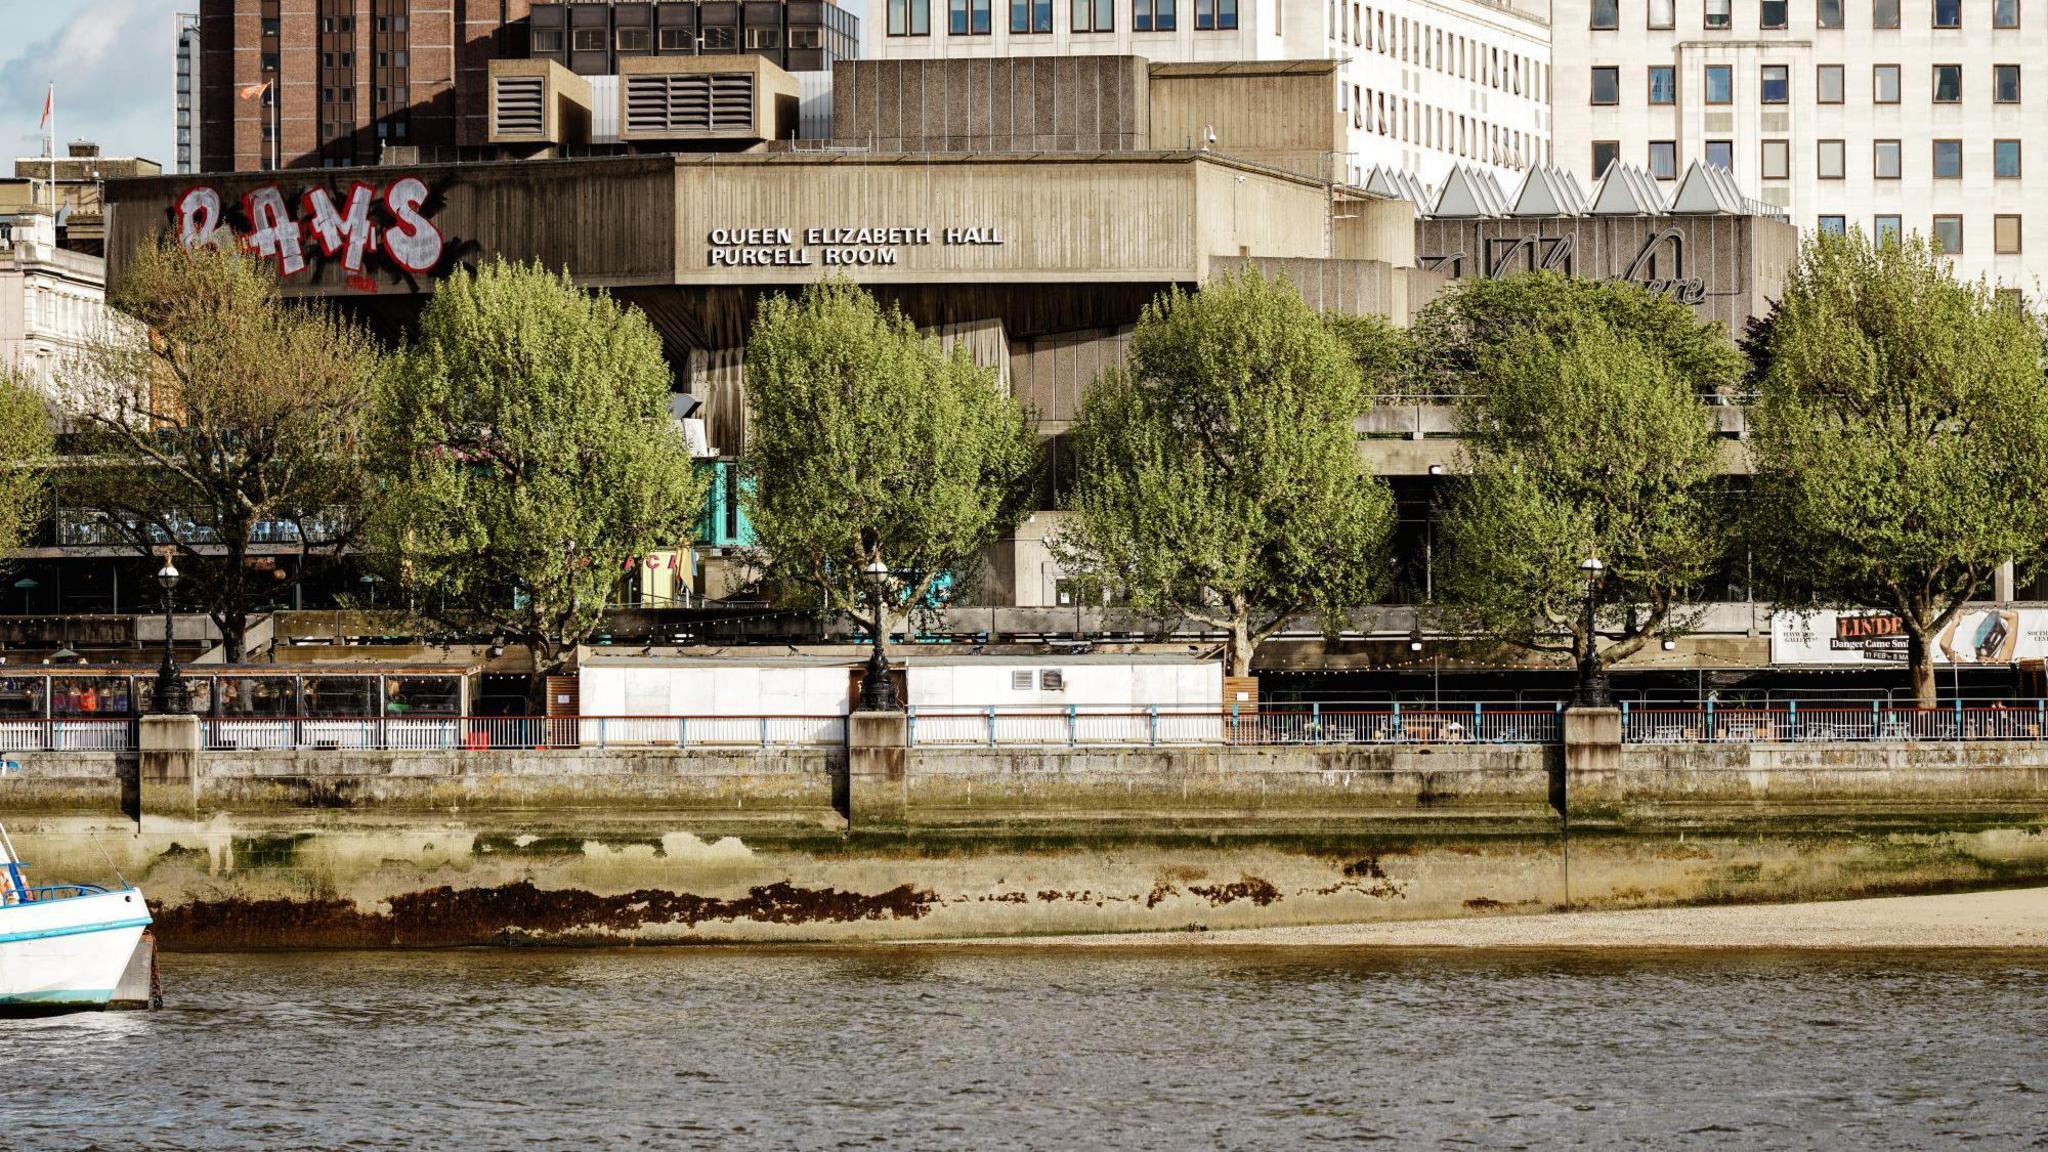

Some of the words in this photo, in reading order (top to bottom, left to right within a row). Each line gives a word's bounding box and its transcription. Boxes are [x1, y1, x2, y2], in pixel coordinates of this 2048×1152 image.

[709, 228, 792, 245] QUEEN
[807, 228, 931, 244] ELIZABETH
[945, 227, 1004, 244] HALL
[709, 248, 812, 265] PURCELL
[825, 248, 898, 265] ROOM
[1841, 616, 1904, 636] LINDE
[1832, 640, 1864, 649] Danger
[1865, 640, 1890, 648] Came
[1891, 640, 1909, 648] Smi
